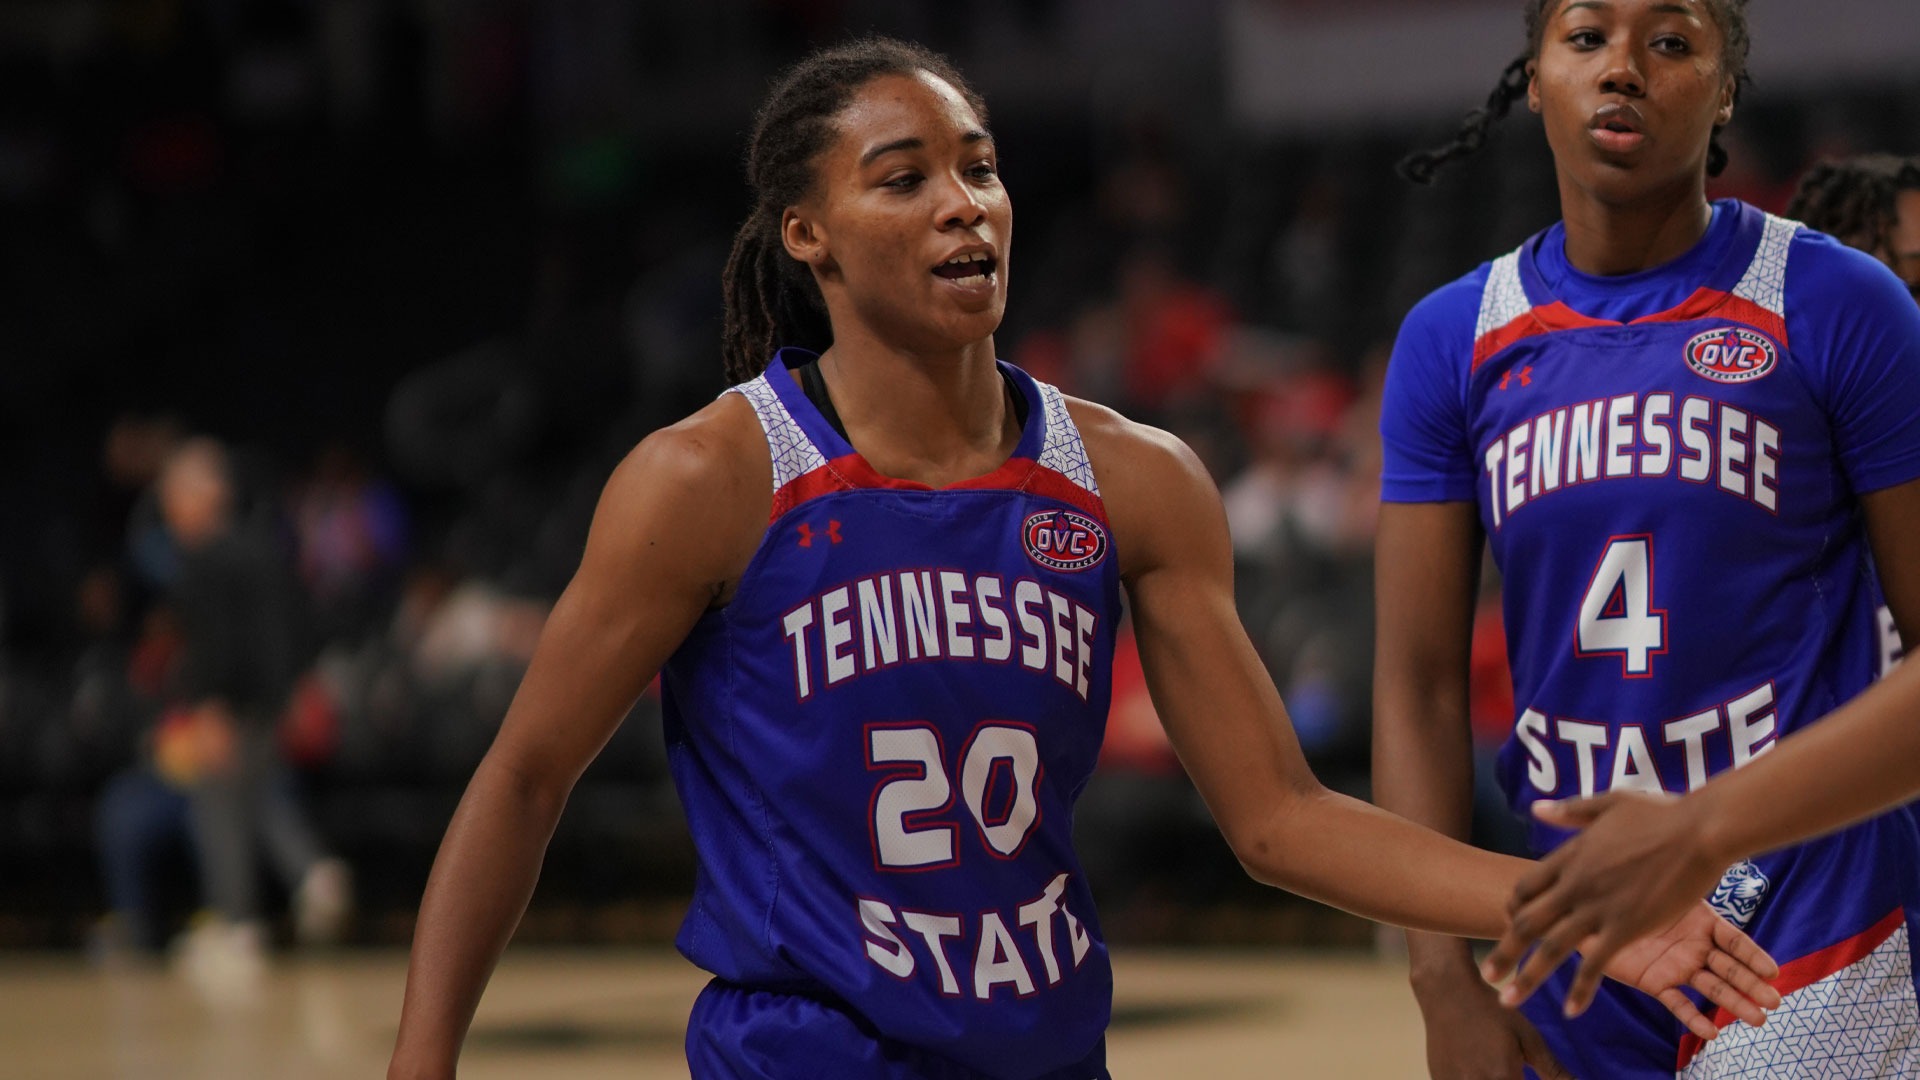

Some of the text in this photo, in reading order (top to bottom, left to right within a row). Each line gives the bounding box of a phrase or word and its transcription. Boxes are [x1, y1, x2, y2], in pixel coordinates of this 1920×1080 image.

[1701, 344, 1756, 368] OVC
[1484, 392, 1781, 528] TENNESSEE
[1031, 549, 1095, 569] CONFERENCE
[1037, 528, 1087, 554] OVC
[1068, 515, 1105, 538] VALLEY
[781, 570, 1097, 702] TENNESSEE
[1576, 536, 1665, 676] 4
[867, 723, 1042, 869] 20
[1515, 681, 1777, 800] STATE
